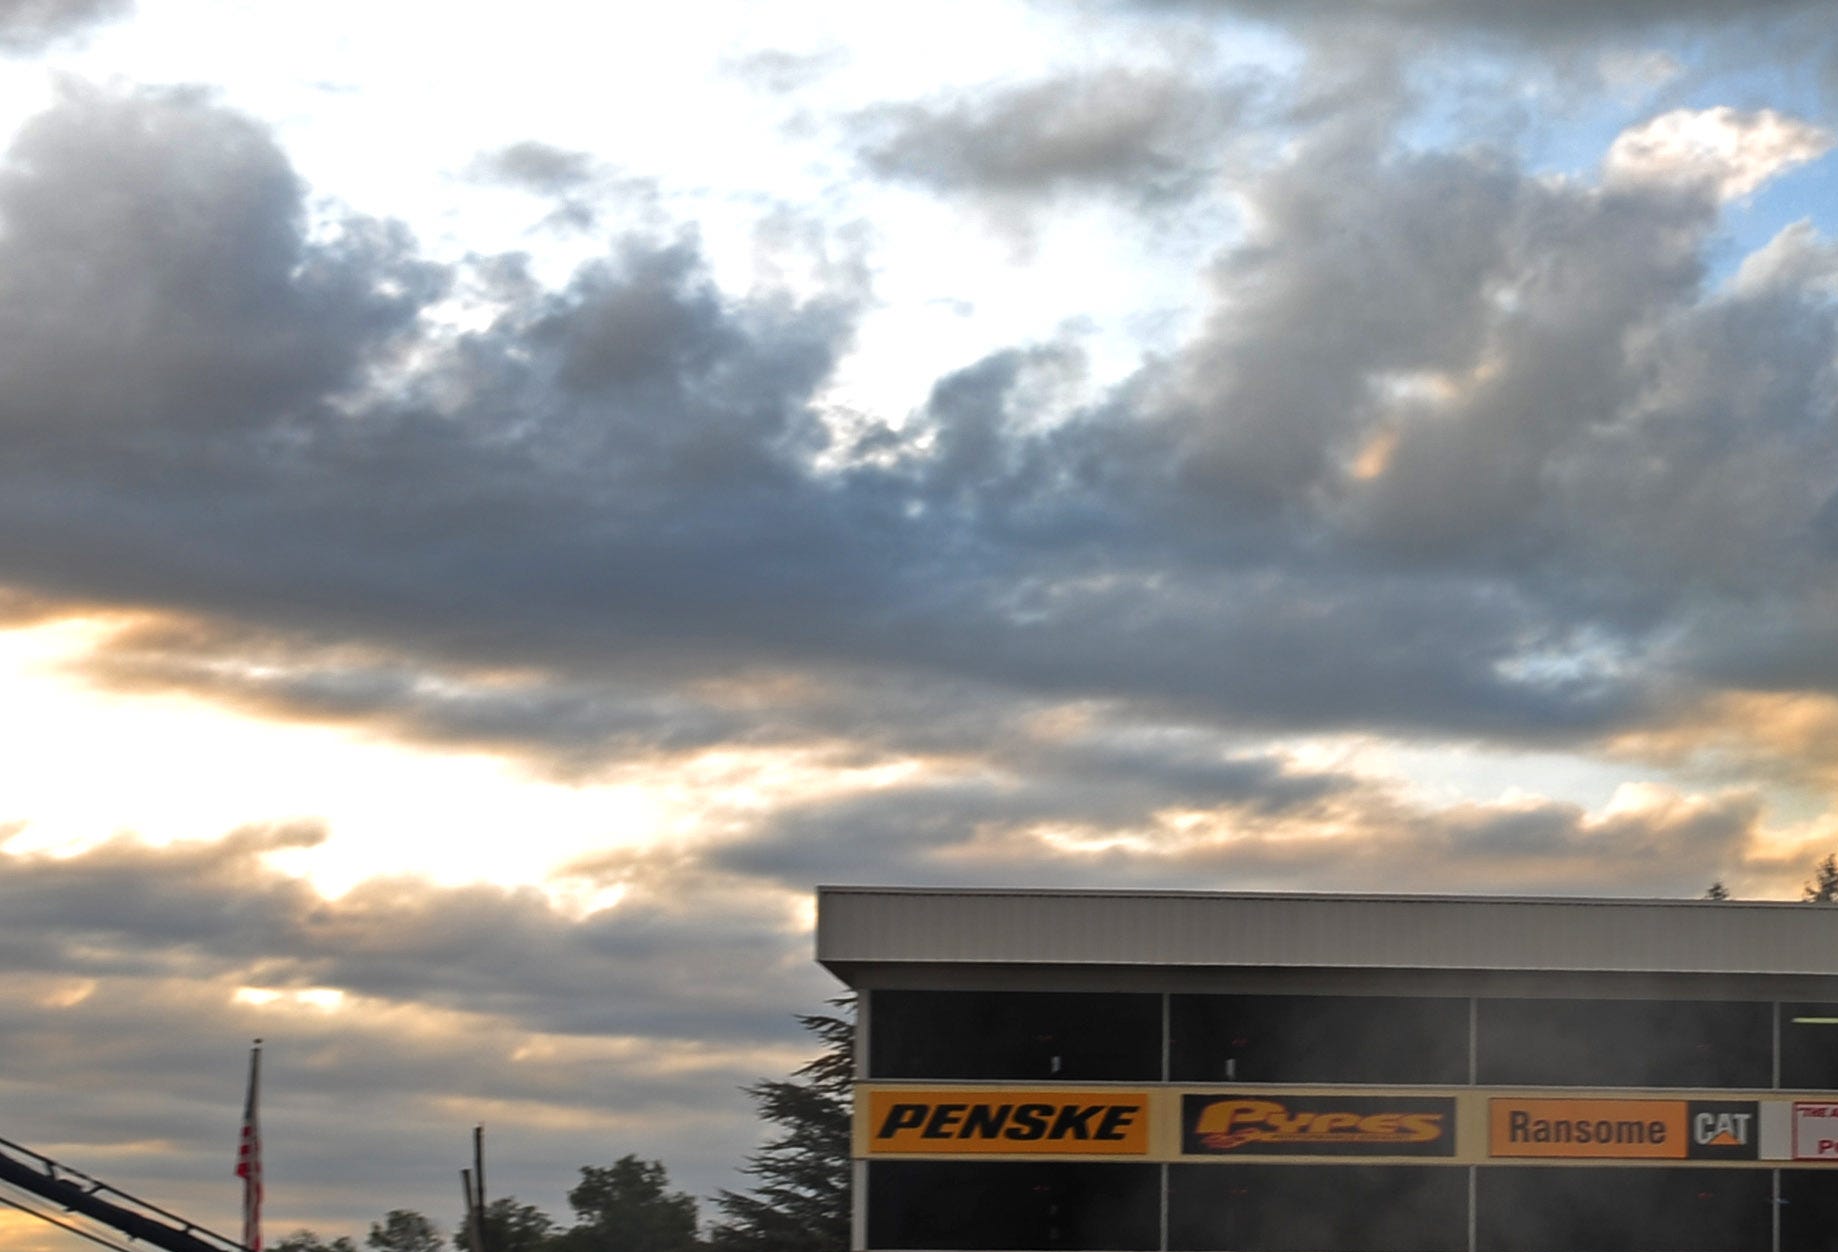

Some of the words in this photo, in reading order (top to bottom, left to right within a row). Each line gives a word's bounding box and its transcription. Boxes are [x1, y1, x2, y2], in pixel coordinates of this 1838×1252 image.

[877, 1103, 1140, 1141] PENSKE
[1508, 1110, 1667, 1146] Ransome
[1693, 1112, 1752, 1147] CAT
